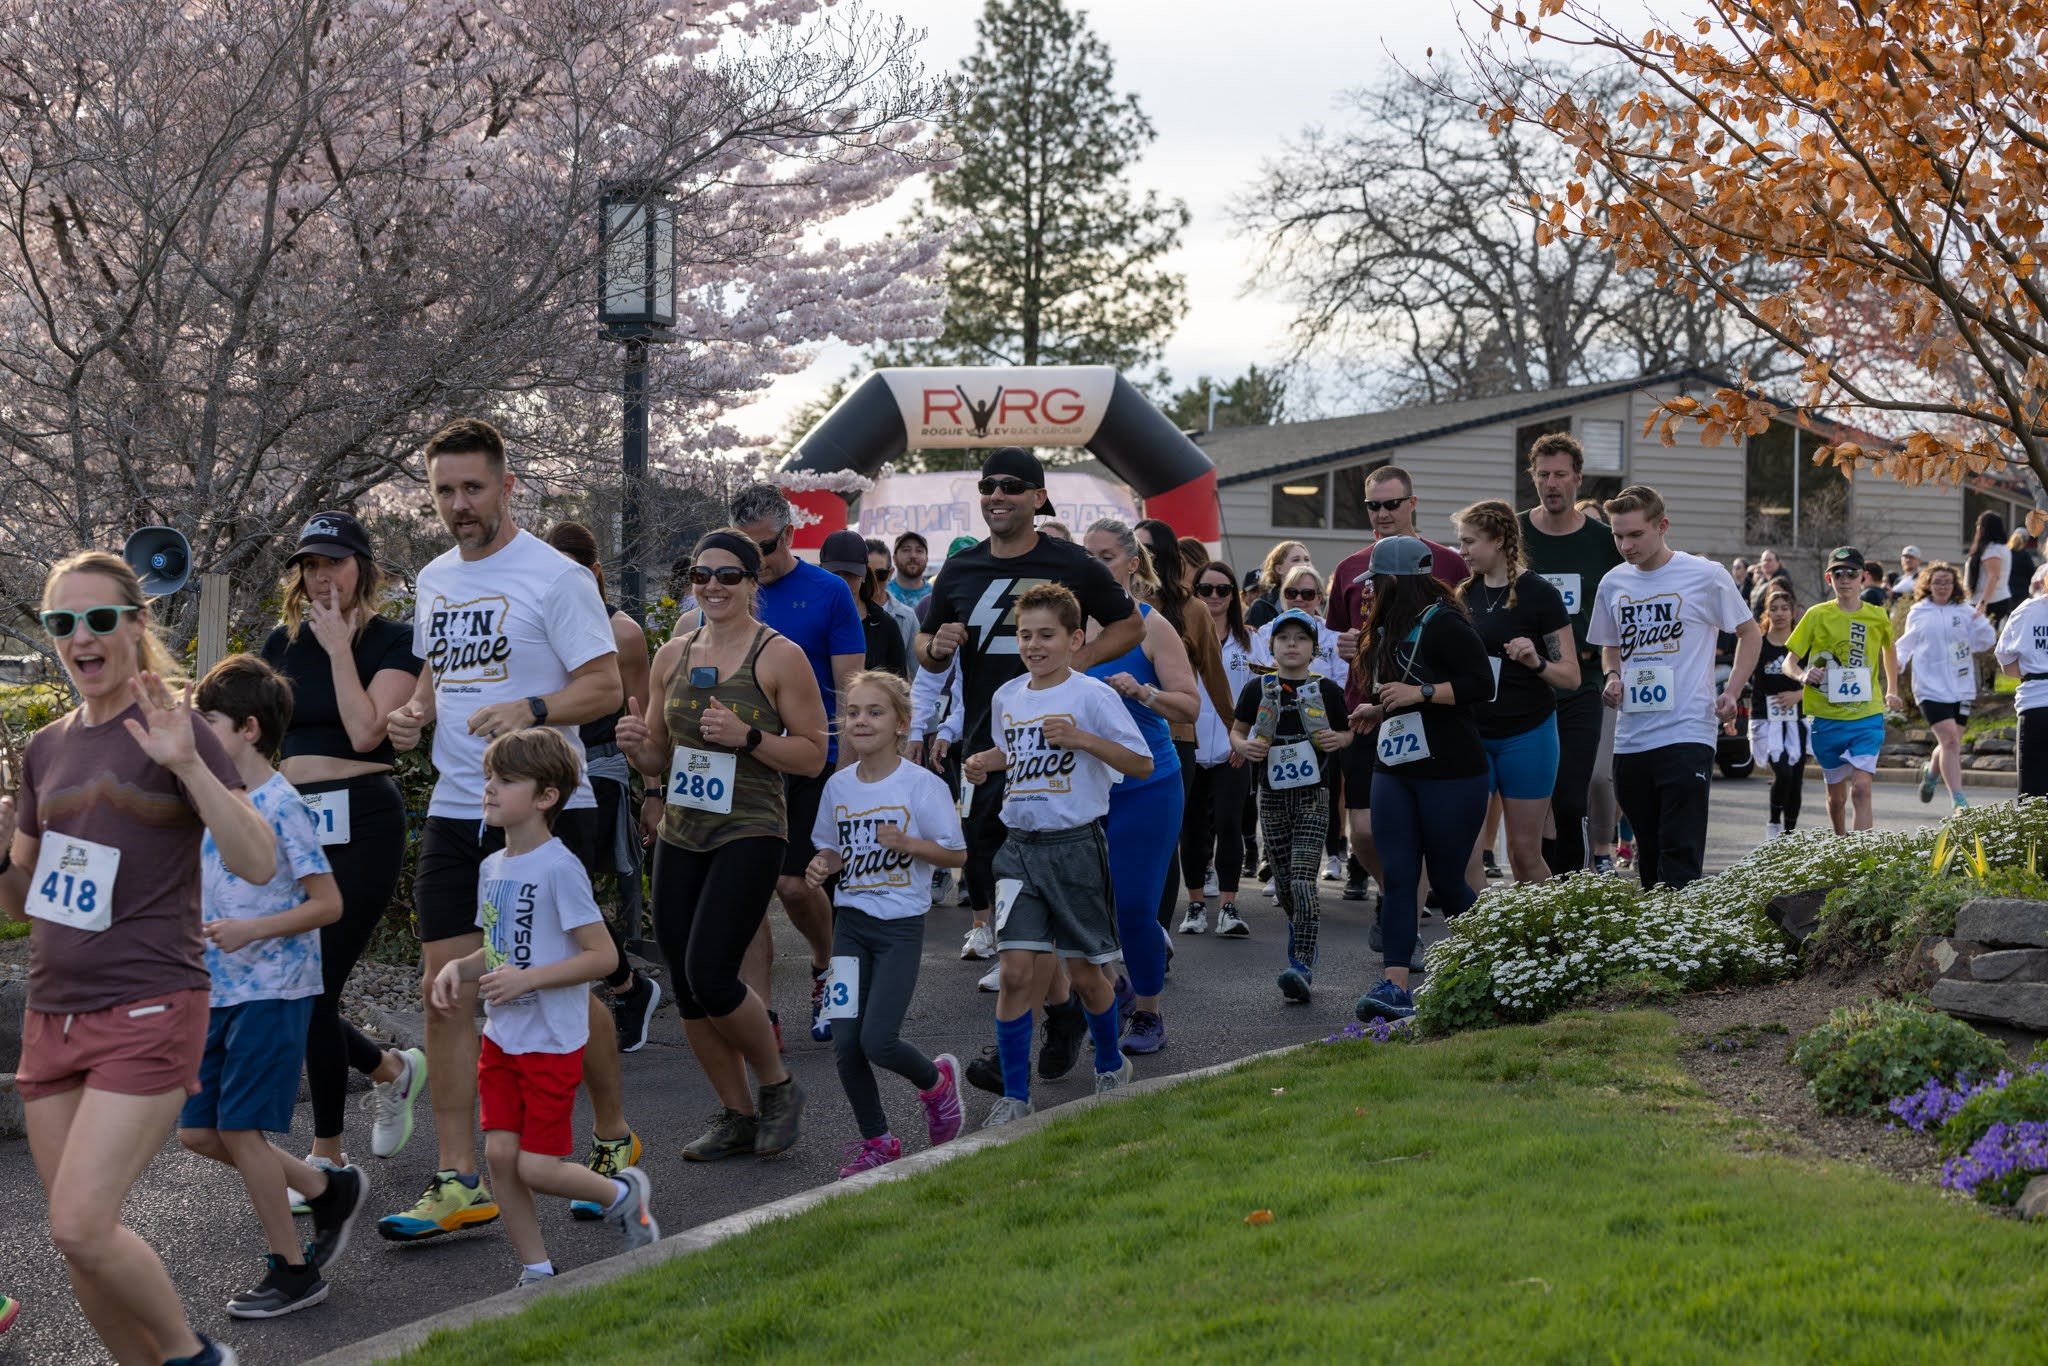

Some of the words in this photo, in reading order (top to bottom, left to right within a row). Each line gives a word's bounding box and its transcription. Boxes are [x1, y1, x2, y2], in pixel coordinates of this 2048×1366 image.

[922, 428, 962, 436] ROGUE
[2033, 625, 2048, 637] KI
[1620, 621, 1684, 662] Grace
[1849, 621, 1866, 669] REFUS
[2035, 639, 2048, 650] M
[427, 636, 512, 690] Grace
[484, 668, 499, 676] 5K
[1630, 684, 1667, 703] 160
[1838, 682, 1861, 696] 46
[1381, 733, 1420, 758] 272
[1272, 760, 1313, 782] 236
[674, 771, 724, 801] 280
[1049, 780, 1063, 789] 5K
[889, 873, 903, 881] 5K
[40, 871, 97, 912] 418
